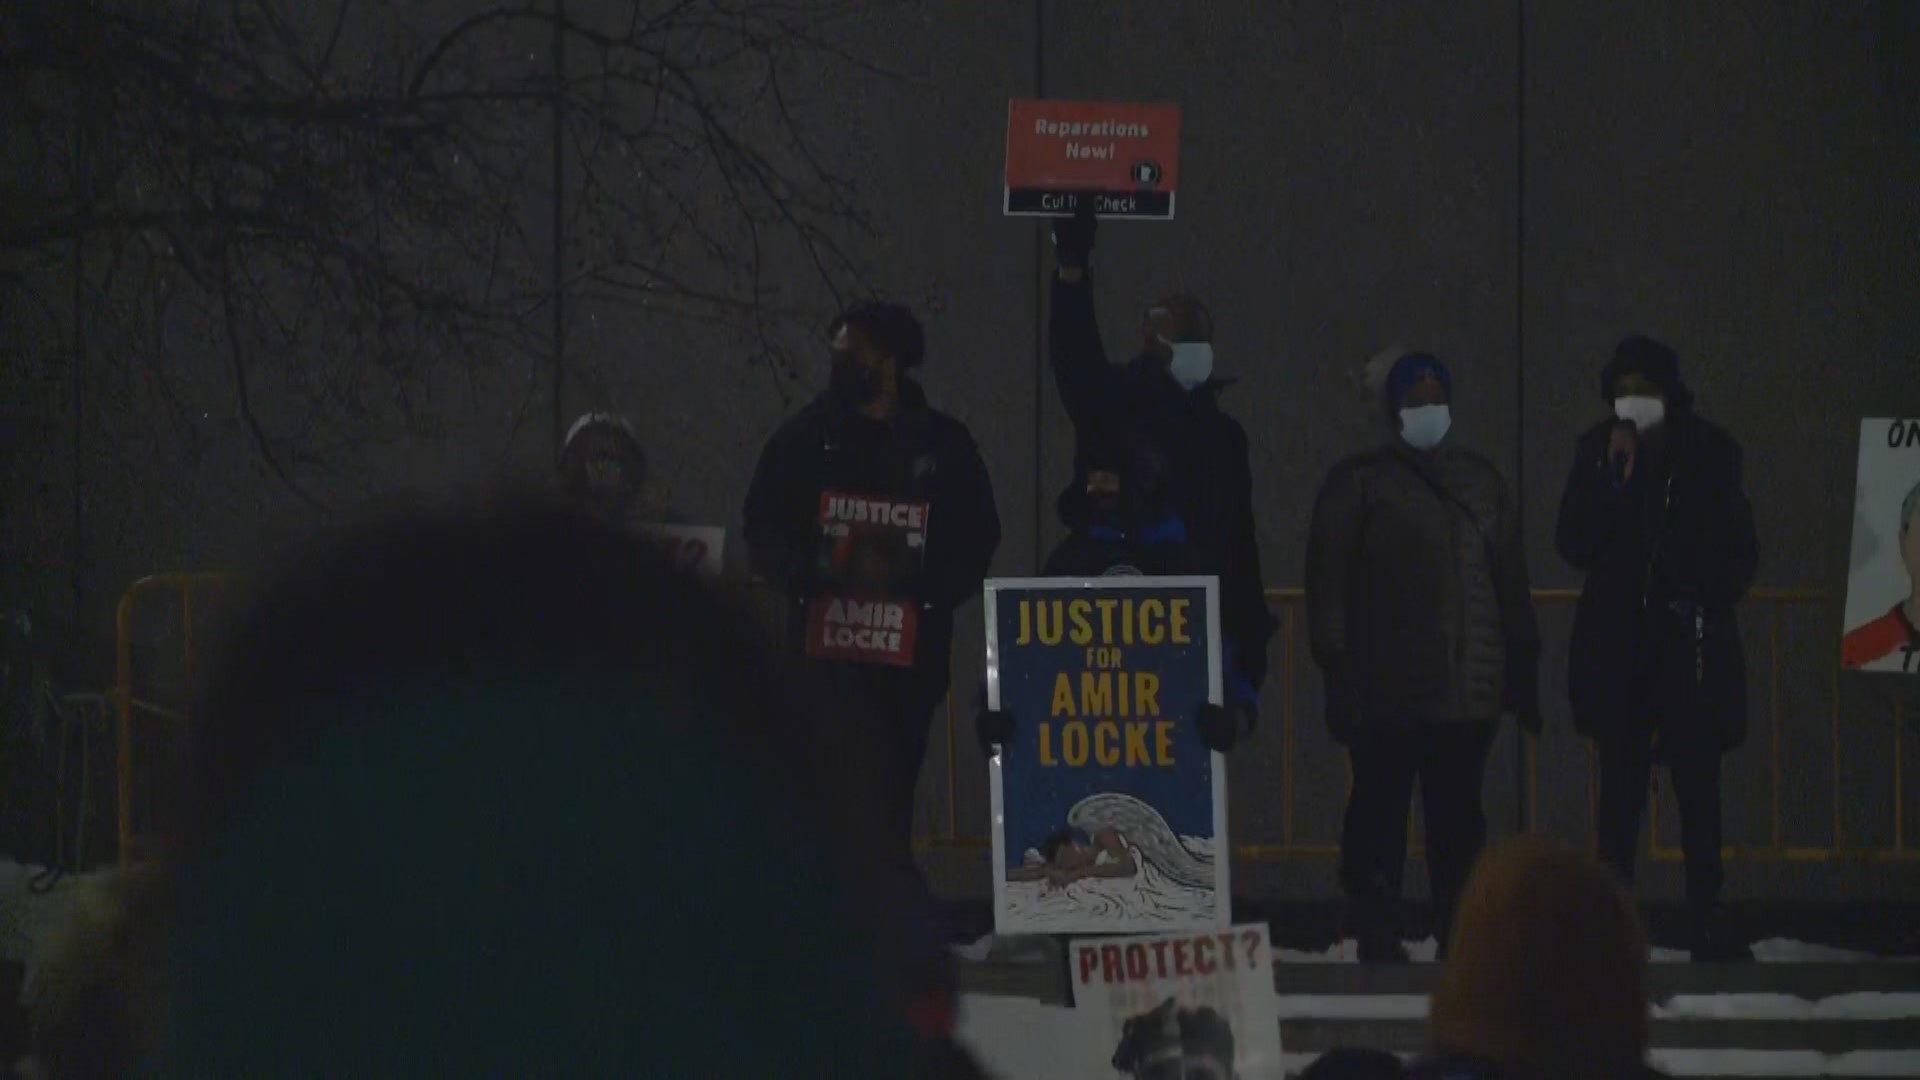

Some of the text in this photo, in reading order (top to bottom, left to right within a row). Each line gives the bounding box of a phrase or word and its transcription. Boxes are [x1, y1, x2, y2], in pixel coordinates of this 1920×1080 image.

[1035, 118, 1149, 138] Reparations
[1065, 142, 1116, 160] Now!
[1094, 195, 1137, 213] Check
[823, 497, 923, 528] JUSTICE
[824, 598, 904, 629] AMIR
[1016, 598, 1191, 646] JUSTICE
[823, 625, 902, 652] LOCKE
[1087, 647, 1122, 668] FOR
[1051, 671, 1160, 717] AMIR
[1038, 720, 1176, 767] LOCKE
[1079, 929, 1262, 985] PROTECT?
